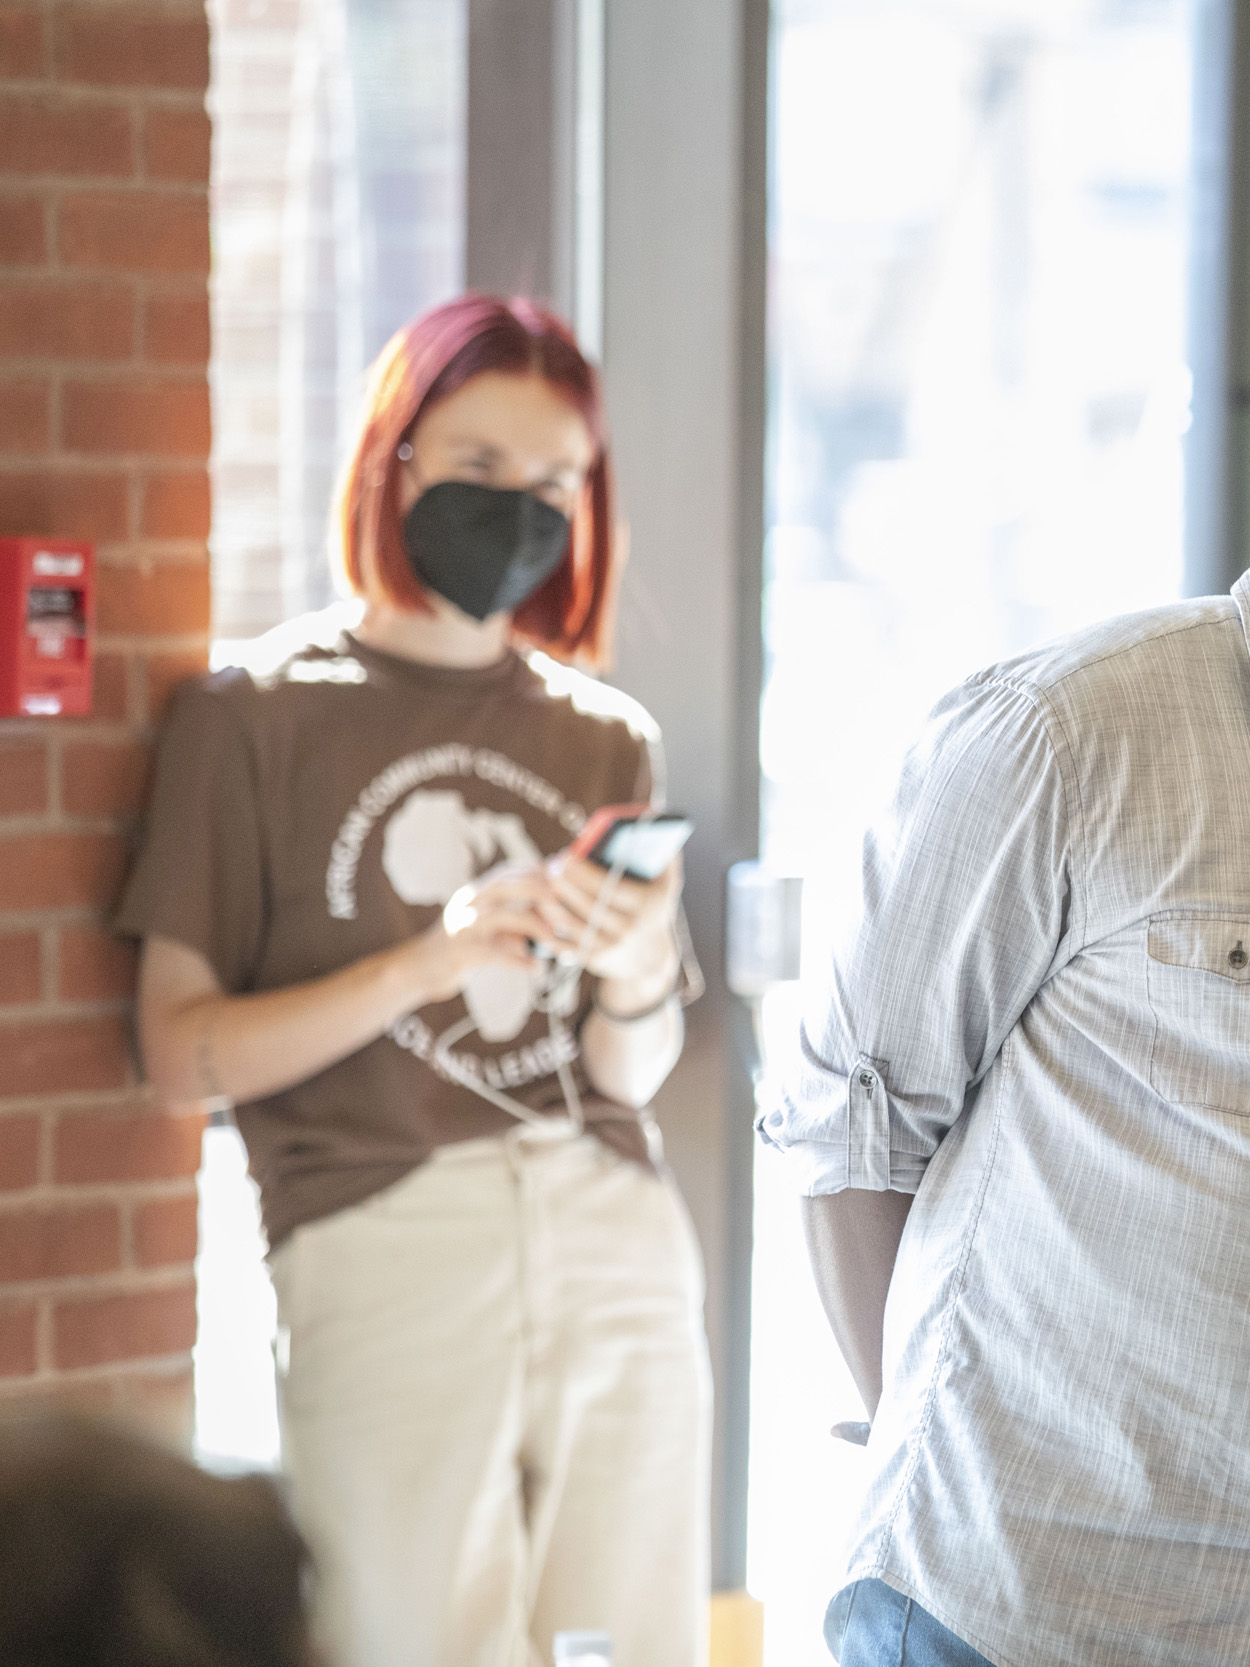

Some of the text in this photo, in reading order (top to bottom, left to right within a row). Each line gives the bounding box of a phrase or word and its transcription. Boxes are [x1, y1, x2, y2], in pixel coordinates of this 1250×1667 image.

[326, 742, 589, 919] AFRICAN COMMUNITY CENTER O
[482, 1030, 579, 1088] LEADE
